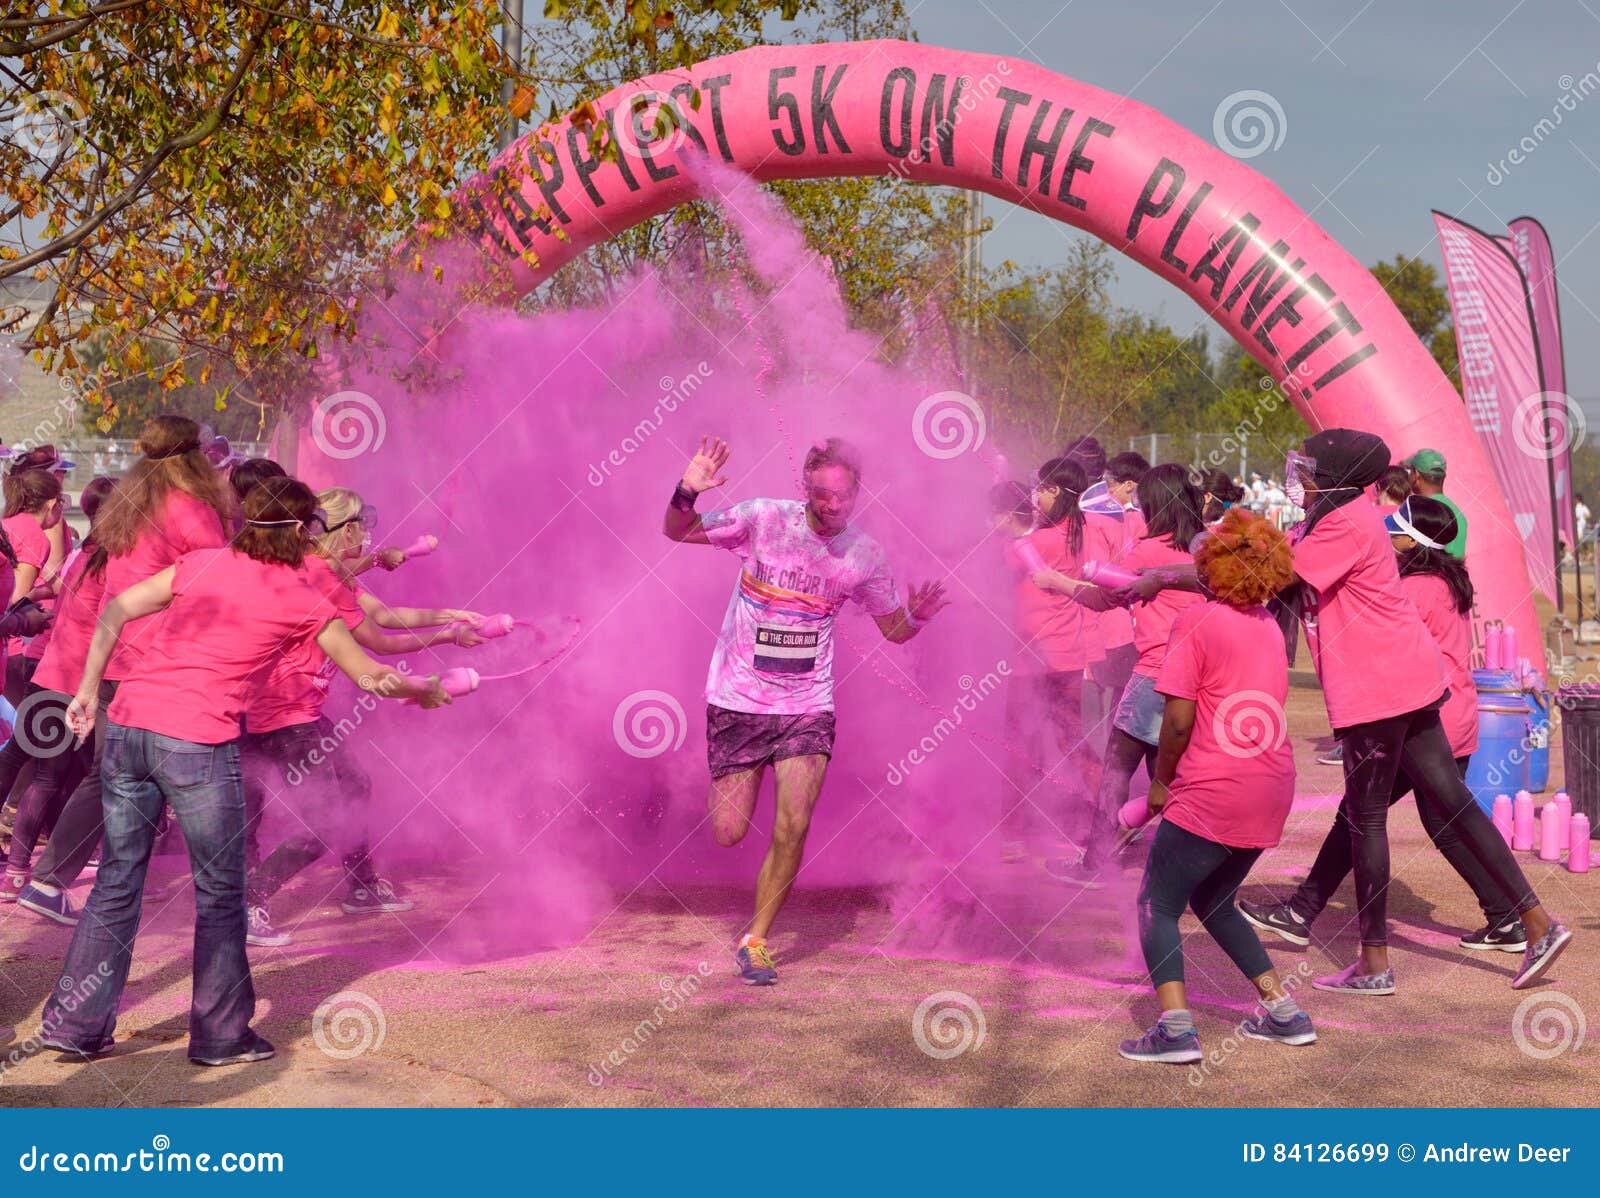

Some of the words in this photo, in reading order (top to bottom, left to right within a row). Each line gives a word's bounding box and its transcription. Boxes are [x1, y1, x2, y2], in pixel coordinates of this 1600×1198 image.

[768, 64, 852, 156] 5K
[880, 66, 964, 167] ON
[992, 86, 1116, 211] THE
[1126, 157, 1378, 400] PLANET!
[770, 632, 783, 645] THE
[783, 633, 805, 646] COLOR
